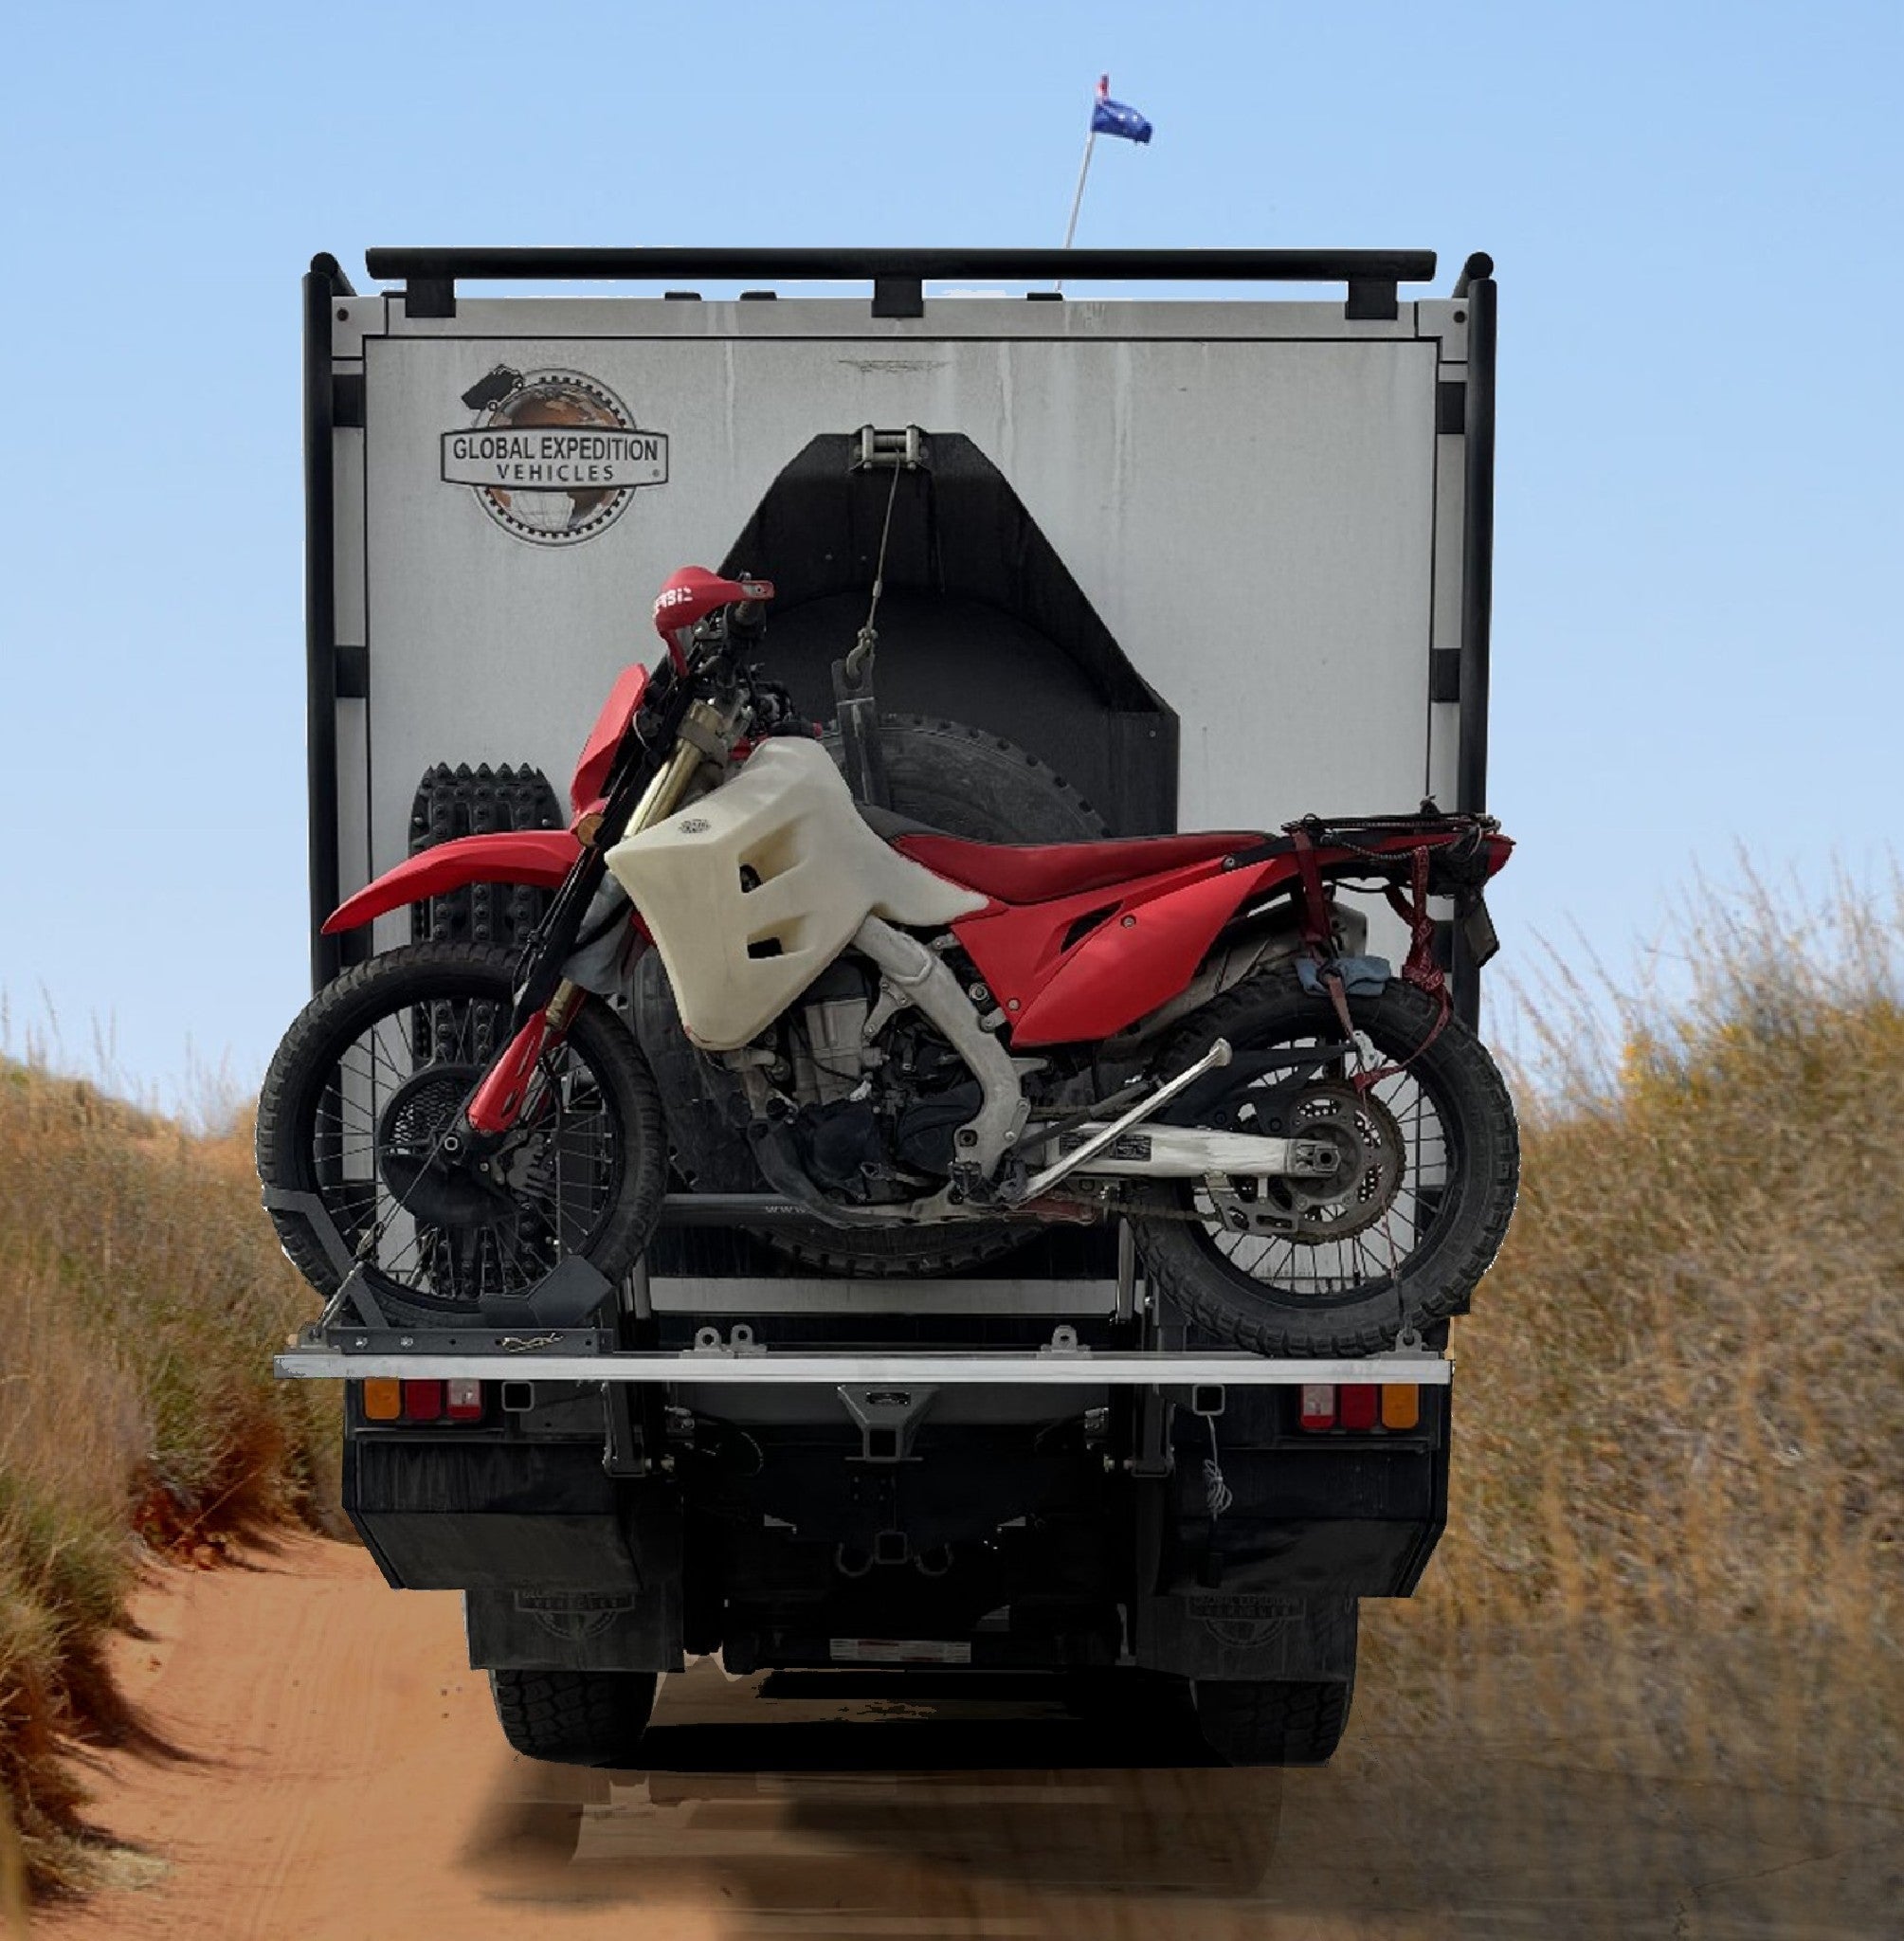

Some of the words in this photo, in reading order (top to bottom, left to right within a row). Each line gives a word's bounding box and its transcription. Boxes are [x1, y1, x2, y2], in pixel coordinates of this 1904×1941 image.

[452, 436, 535, 461] GLOBAL
[541, 436, 659, 462] EXPEDITION
[496, 463, 615, 481] VEHICLES
